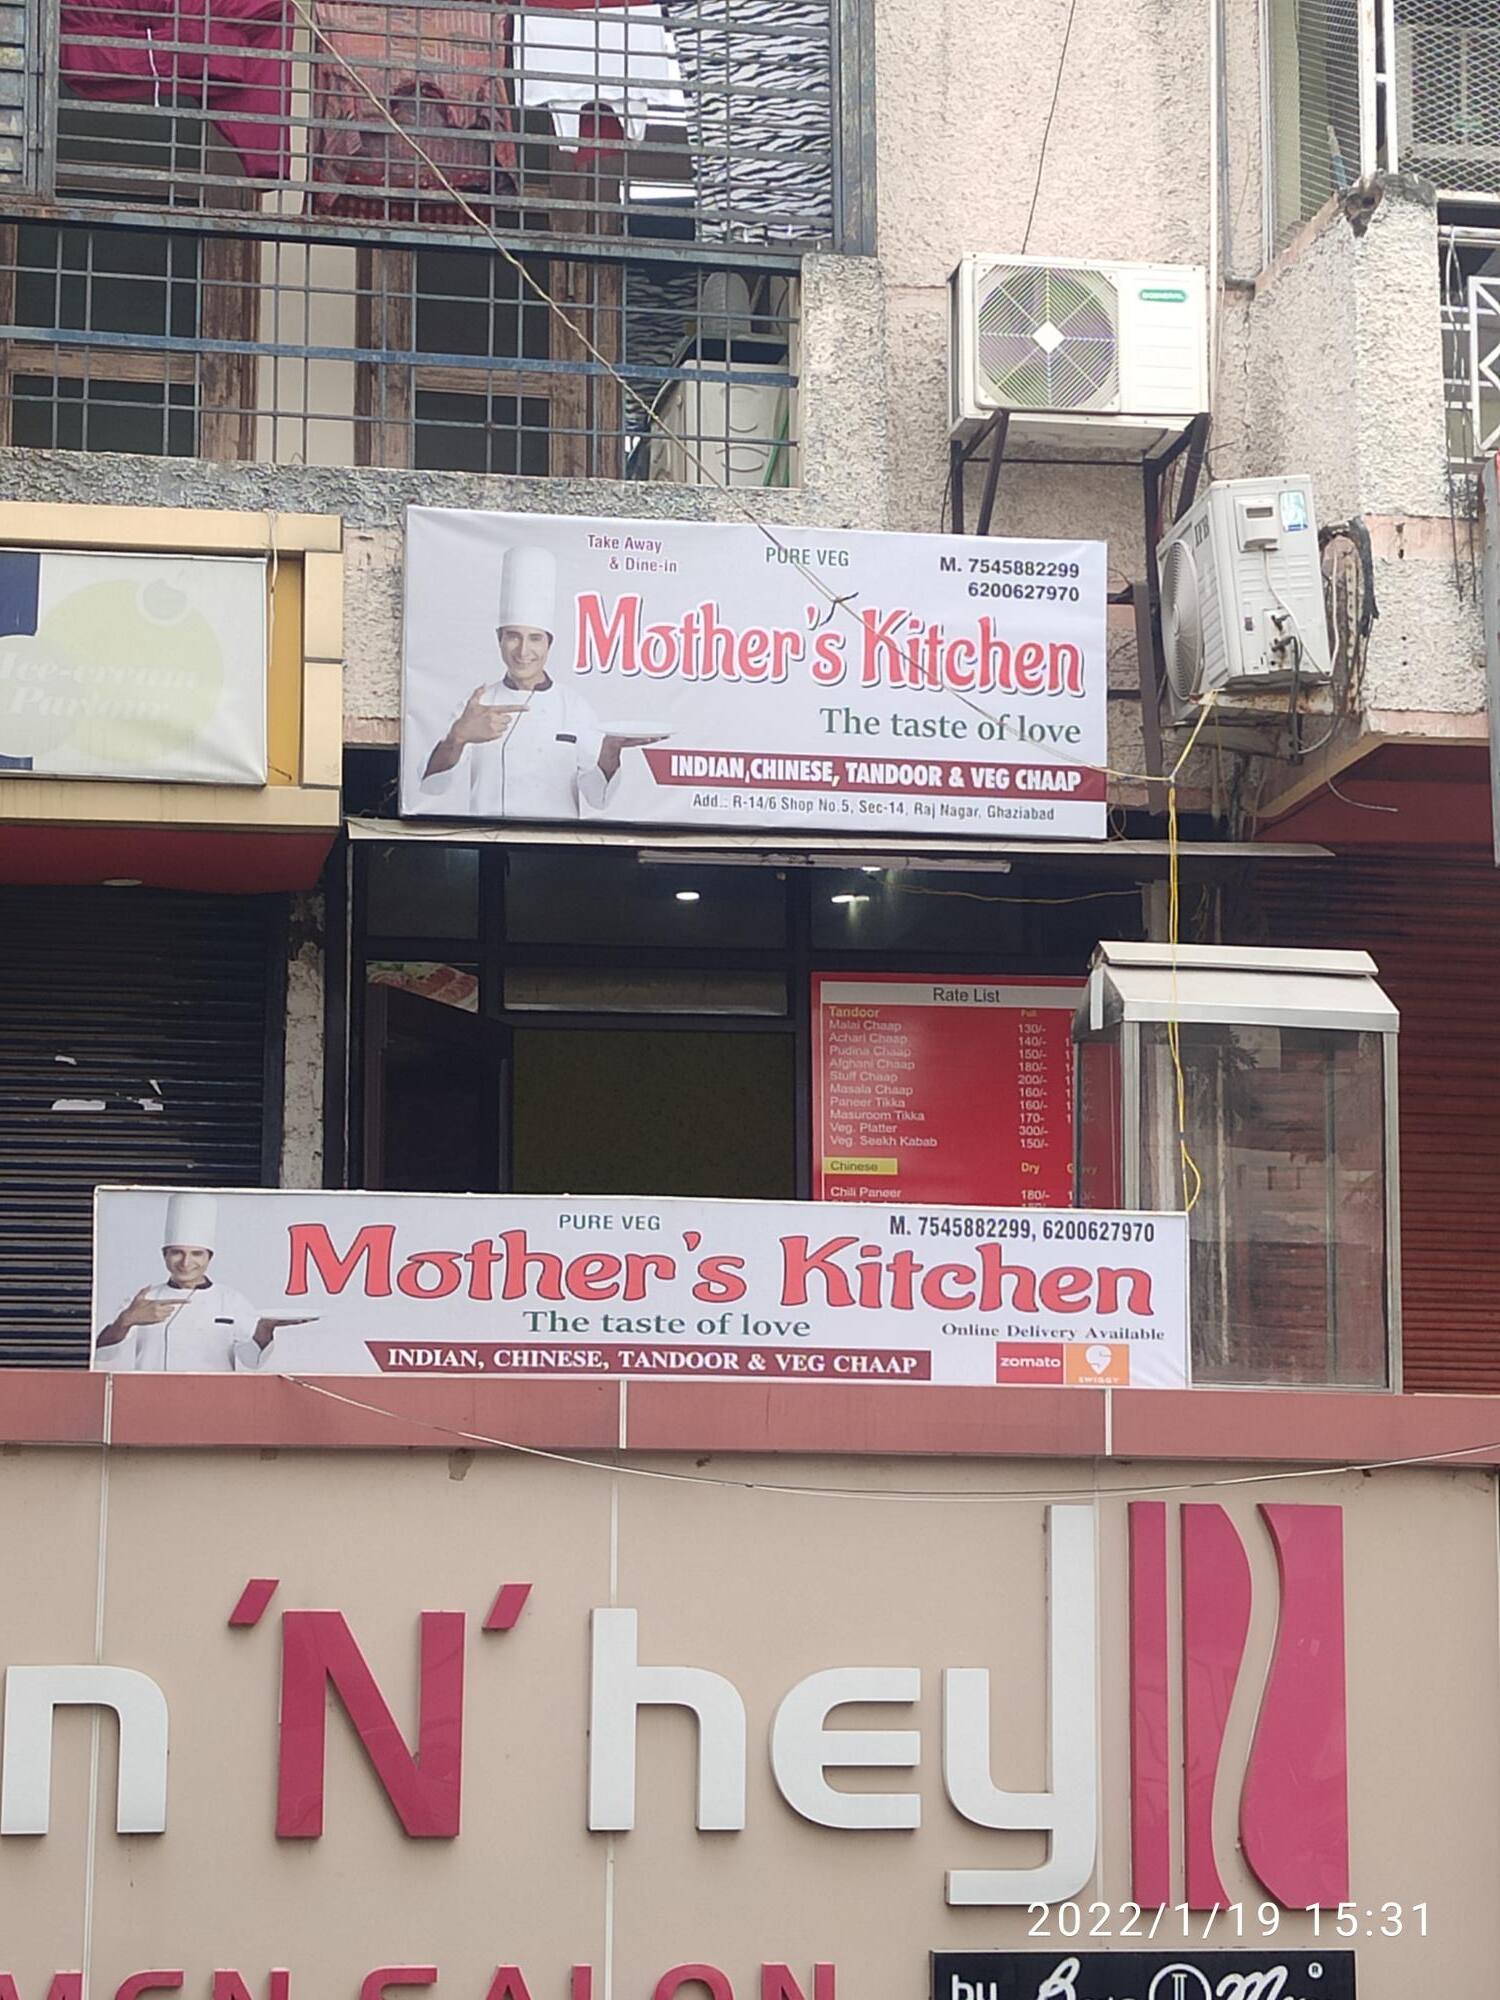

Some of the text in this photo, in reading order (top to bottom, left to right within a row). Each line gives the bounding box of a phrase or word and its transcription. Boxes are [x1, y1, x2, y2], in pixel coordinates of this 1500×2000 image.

[588, 534, 662, 553] Take Away
[609, 557, 677, 573] & Dine-in
[766, 547, 849, 567] PURE VEG
[940, 557, 1080, 579] M. 7545882299
[968, 582, 1080, 602] 6200627970
[575, 593, 1084, 695] Mother's Kitchen
[820, 707, 1081, 743] The taste of love
[845, 761, 942, 788] TANDOOR
[949, 766, 965, 788] &
[970, 767, 1010, 790] VEG
[1015, 769, 1081, 792] CHAAP
[733, 795, 776, 811] R-14/6
[781, 797, 813, 814] Shop
[914, 802, 936, 820] Raj
[987, 805, 1054, 821] Ghaziabad
[933, 987, 1000, 1003] Rate List
[829, 1006, 880, 1018] Tandoor
[863, 1020, 902, 1032] Chaap
[869, 1033, 908, 1045] Chaap
[1019, 1037, 1047, 1047] 140/-
[873, 1046, 911, 1058] Chaap
[876, 1059, 915, 1071] Chaap
[1019, 1062, 1047, 1073] 180/-
[859, 1072, 898, 1083] Chaap
[1018, 1075, 1047, 1085] 200/-
[830, 1083, 871, 1094] Masala
[875, 1084, 913, 1096] Chaap
[830, 1096, 871, 1107] Paneer
[875, 1097, 905, 1108] Tikka
[895, 1110, 925, 1121] Tikka
[860, 1122, 898, 1133] Platter
[1019, 1126, 1048, 1136] 300/-
[900, 1137, 938, 1147] Kabab
[830, 1160, 1040, 1175] Chinese Dry
[830, 1186, 1050, 1200] Chili Paneer 180/-
[558, 1213, 661, 1231] PURE VEG
[889, 1215, 1155, 1243] M. 7545882299, 6200627970
[285, 1223, 1155, 1317] Mother's Kitchen
[524, 1311, 811, 1338] The taste of love
[942, 1323, 1164, 1341] Online Delivery Available
[388, 1348, 917, 1375] INDIAN, CHINESE, TANDOOR & VEG CHAAP
[1000, 1356, 1061, 1368] zomato
[586, 1504, 1098, 1906] hey
